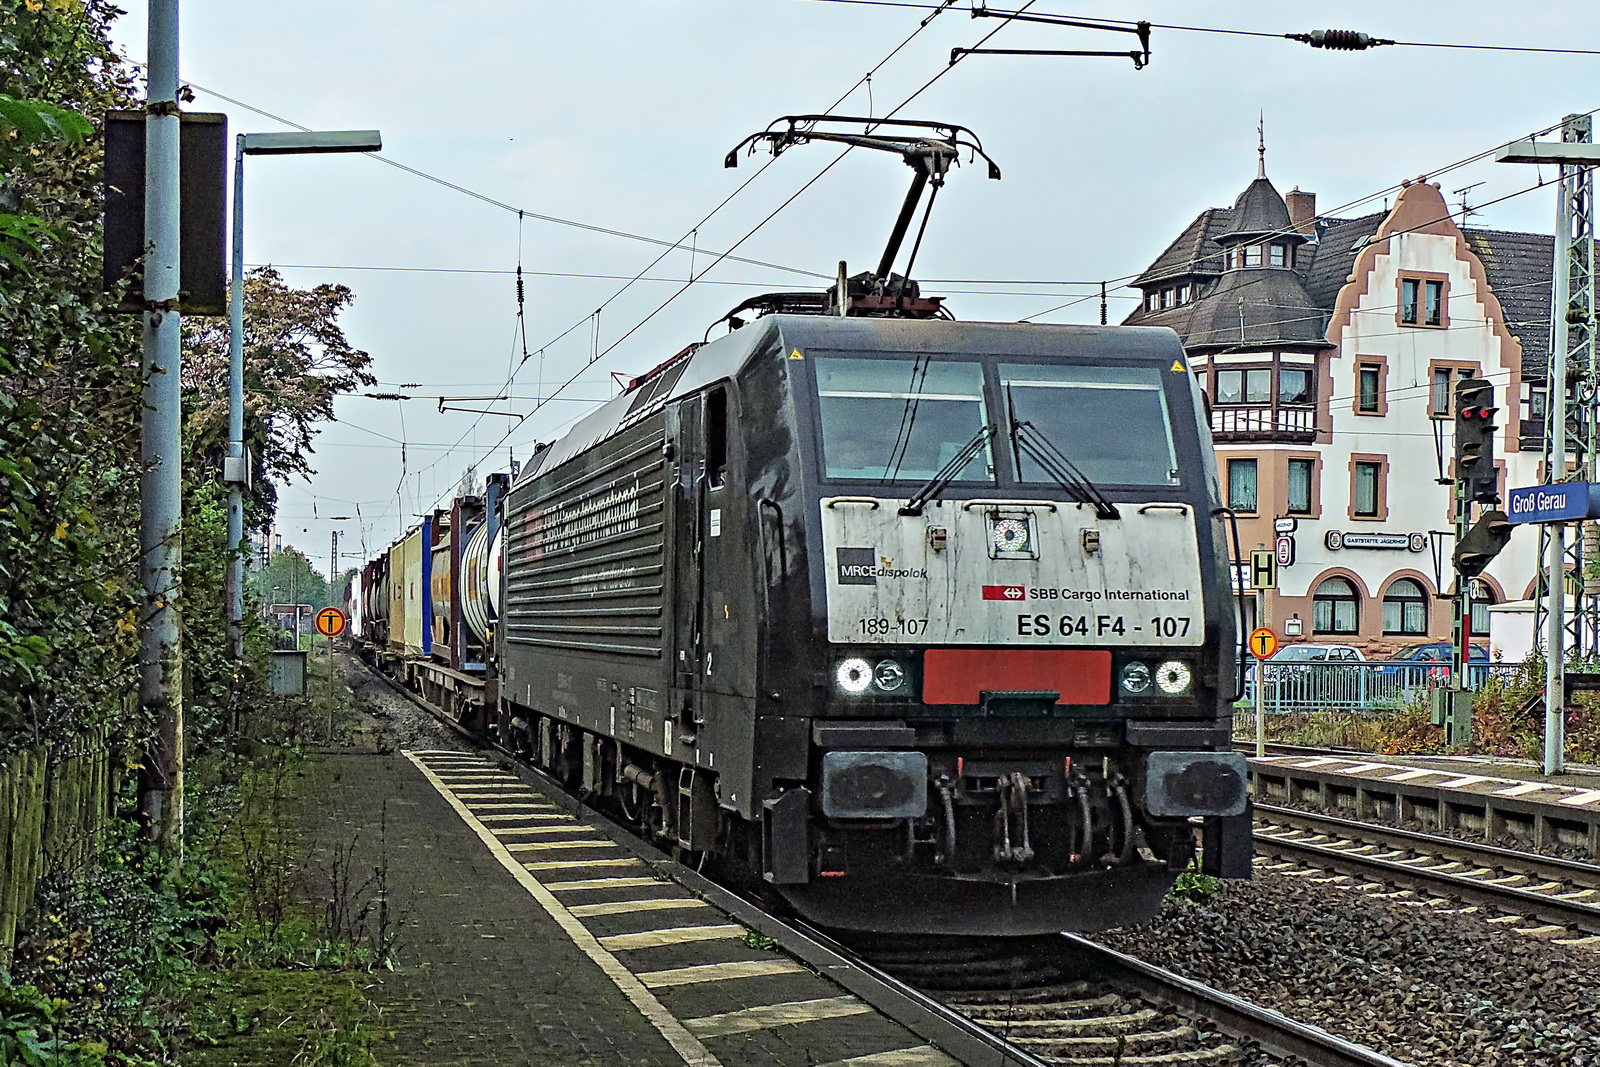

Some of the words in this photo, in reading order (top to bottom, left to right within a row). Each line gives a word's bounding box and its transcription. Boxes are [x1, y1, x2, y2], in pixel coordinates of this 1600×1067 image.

[1513, 493, 1535, 514] Groß
[1537, 491, 1566, 511] Gerau
[1253, 554, 1273, 586] H
[1029, 588, 1059, 600] SBB
[1062, 588, 1102, 602] Cargo
[1104, 588, 1190, 601] International
[858, 618, 929, 636] 189-107
[1017, 614, 1050, 636] ES
[1059, 615, 1089, 637] 64
[1098, 616, 1126, 637] F4
[1151, 616, 1191, 638] 107
[706, 651, 712, 676] 2
